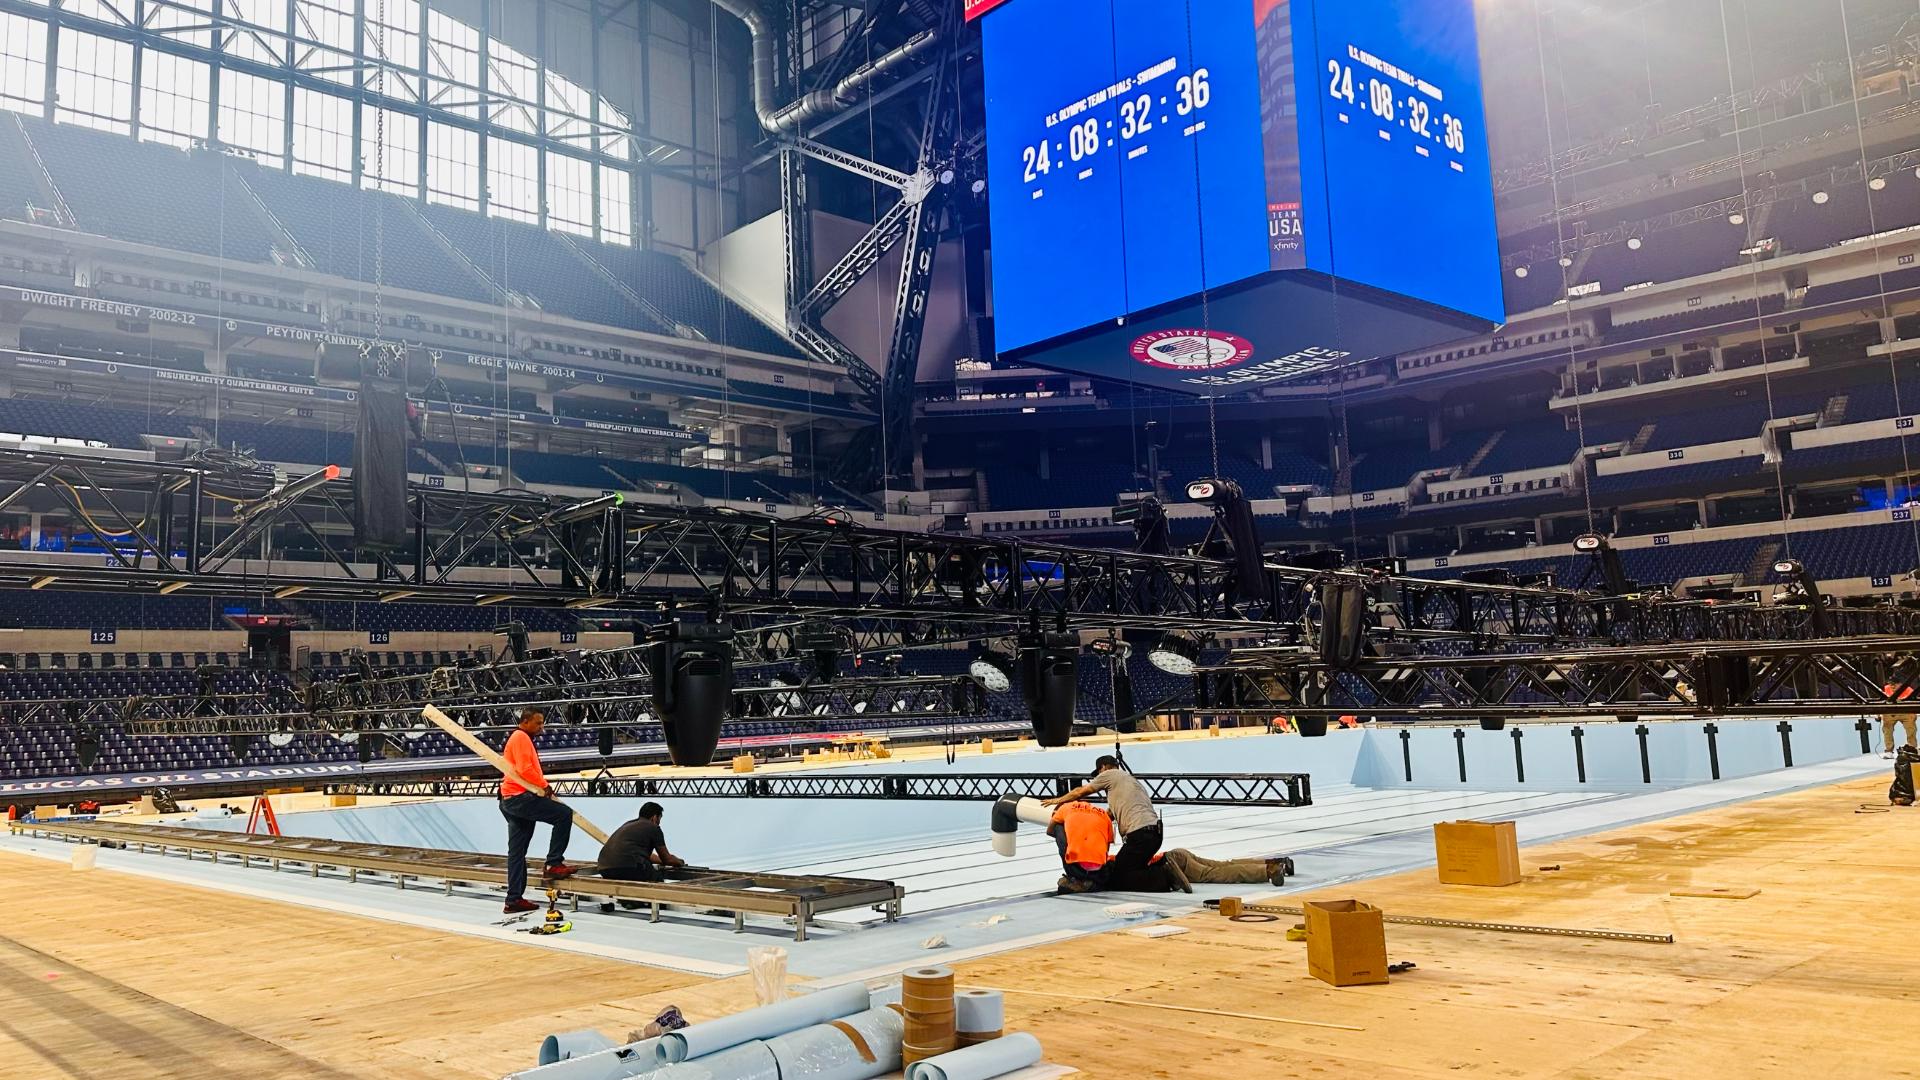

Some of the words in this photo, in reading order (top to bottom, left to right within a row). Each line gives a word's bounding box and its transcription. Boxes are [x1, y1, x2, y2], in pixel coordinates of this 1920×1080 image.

[1045, 112, 1059, 128] U.S.
[1059, 98, 1087, 122] OLYMPIC
[1087, 89, 1106, 108] TEAM
[1106, 77, 1132, 99] TRIALS
[1328, 59, 1354, 104] 24
[1369, 78, 1394, 122] 08
[1408, 96, 1431, 139] 32
[1443, 113, 1464, 154] 36
[1023, 139, 1050, 184] 24
[1069, 118, 1099, 162] 08
[1120, 94, 1152, 140] 32
[1176, 68, 1210, 116] 36
[1272, 210, 1297, 219] TEAM
[1269, 218, 1303, 237] USA
[1273, 241, 1299, 251] xfinity
[21, 290, 76, 308] DWIGHT
[80, 300, 141, 317] FREENEY
[149, 309, 196, 325] 2002-12
[266, 326, 311, 342] PEYTON
[1158, 330, 1208, 339] STATES
[468, 355, 503, 369] REGGIE
[506, 360, 538, 373] WAYNE
[543, 366, 576, 379] 2001-14
[1226, 346, 1331, 377] OLYMPIC
[156, 370, 225, 385] INSUREPLICITY
[226, 378, 288, 393] QUARTERBACK
[289, 385, 315, 396] SUITE
[585, 421, 632, 433] INSUREPLICITY
[632, 427, 675, 437] QUARTERBACK
[674, 431, 693, 439] SUITE
[430, 477, 443, 486] 327
[1893, 510, 1909, 519] 237
[1655, 536, 1668, 544] 236
[1873, 577, 1889, 586] 137
[93, 632, 114, 642] 125
[371, 632, 388, 642] 126
[561, 633, 576, 642] 127
[1, 777, 124, 792] LUCAS
[131, 773, 195, 785] OIL
[200, 764, 351, 781] STADIUM
